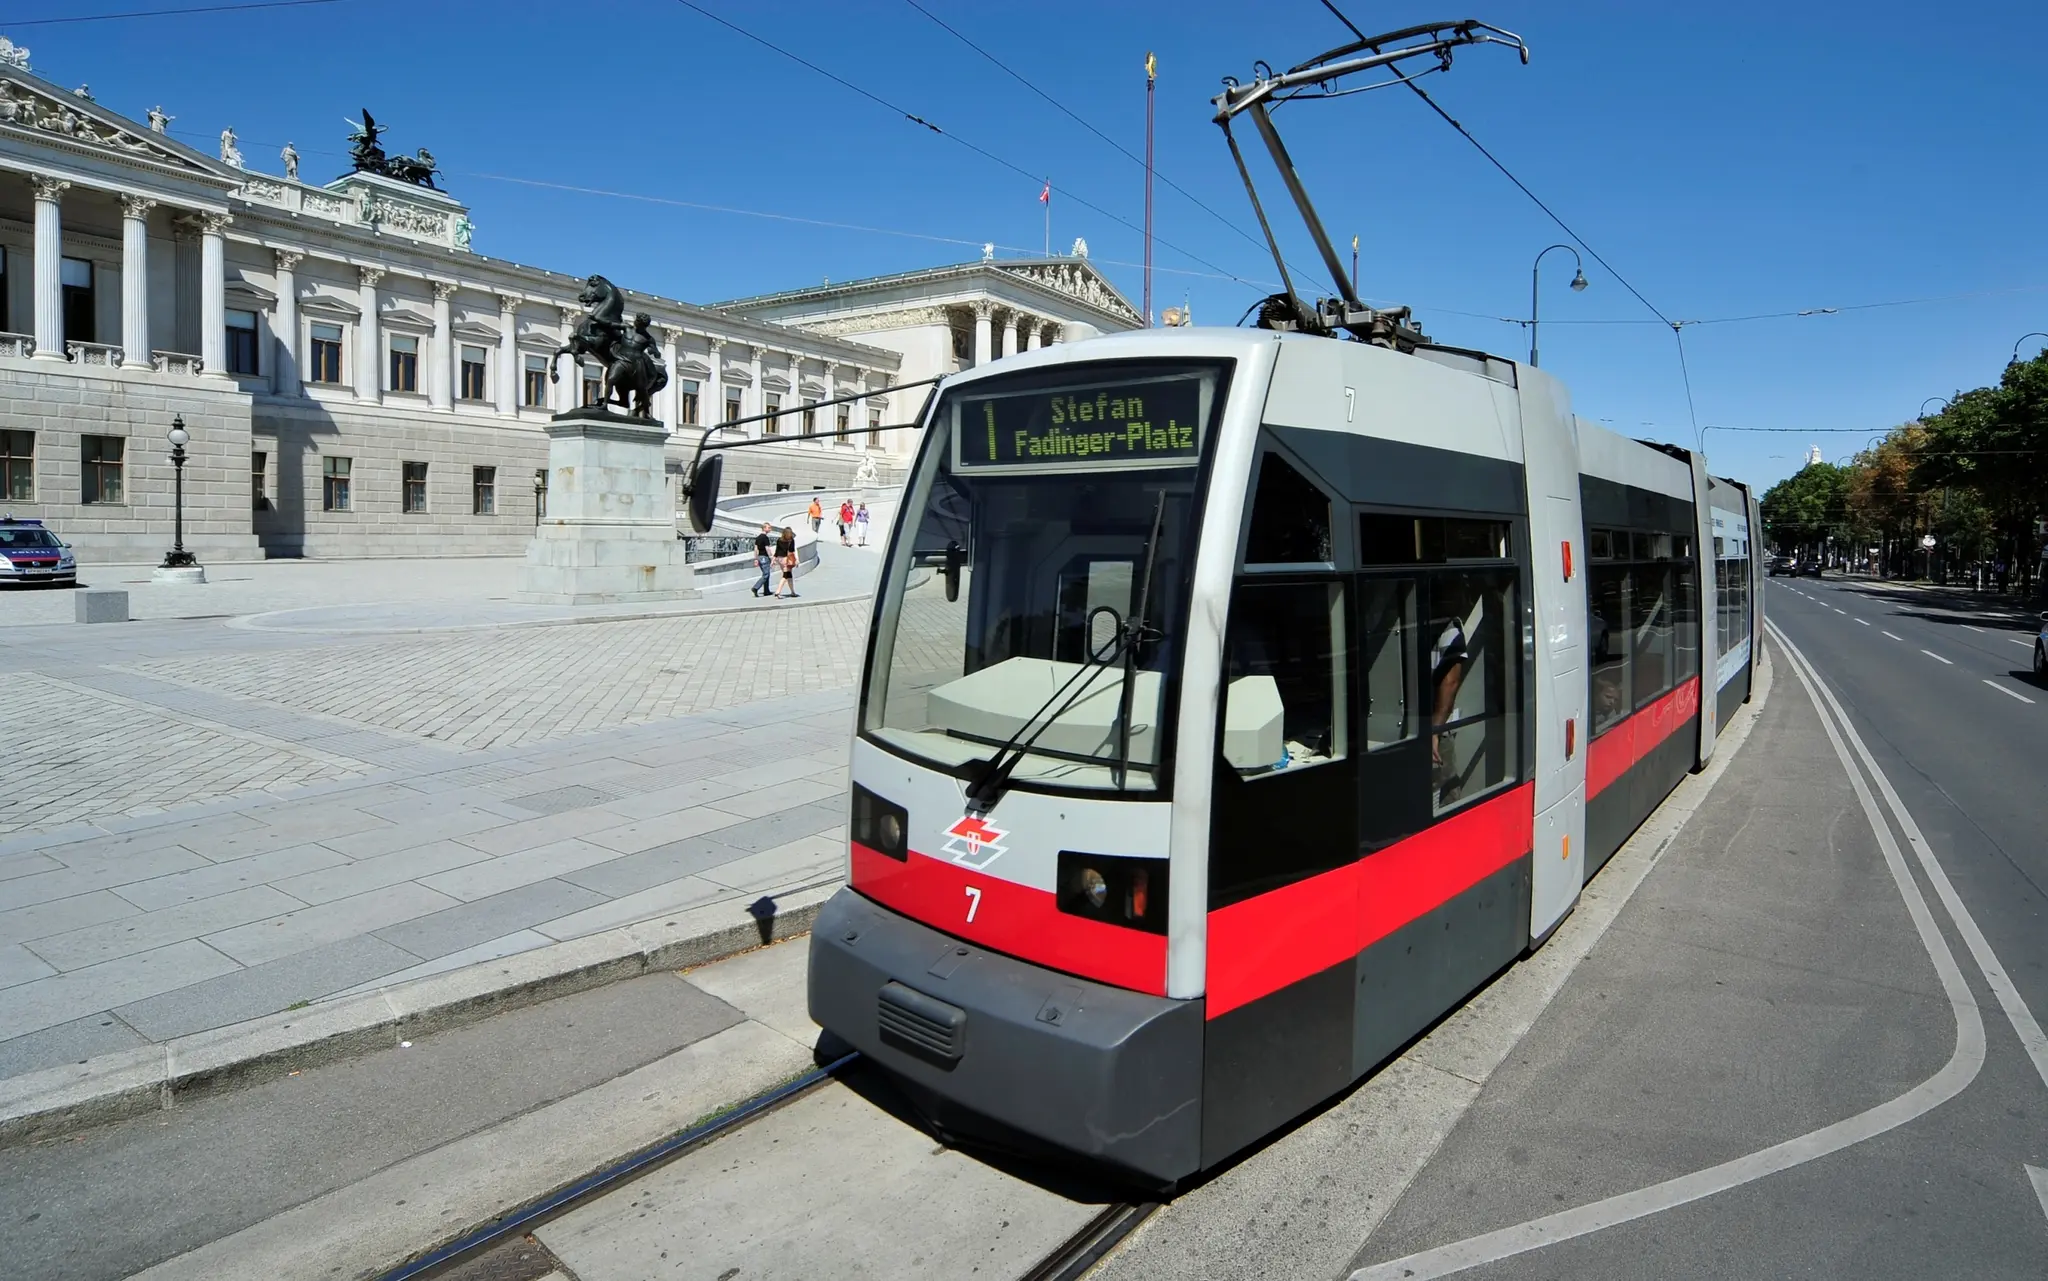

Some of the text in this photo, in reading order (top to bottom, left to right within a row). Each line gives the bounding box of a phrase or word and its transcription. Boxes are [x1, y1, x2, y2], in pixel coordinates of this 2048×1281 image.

[1344, 385, 1357, 424] 7
[982, 392, 1144, 460] 1 Stefan
[1015, 419, 1194, 457] Fadinger-Platz
[965, 885, 982, 923] 7
